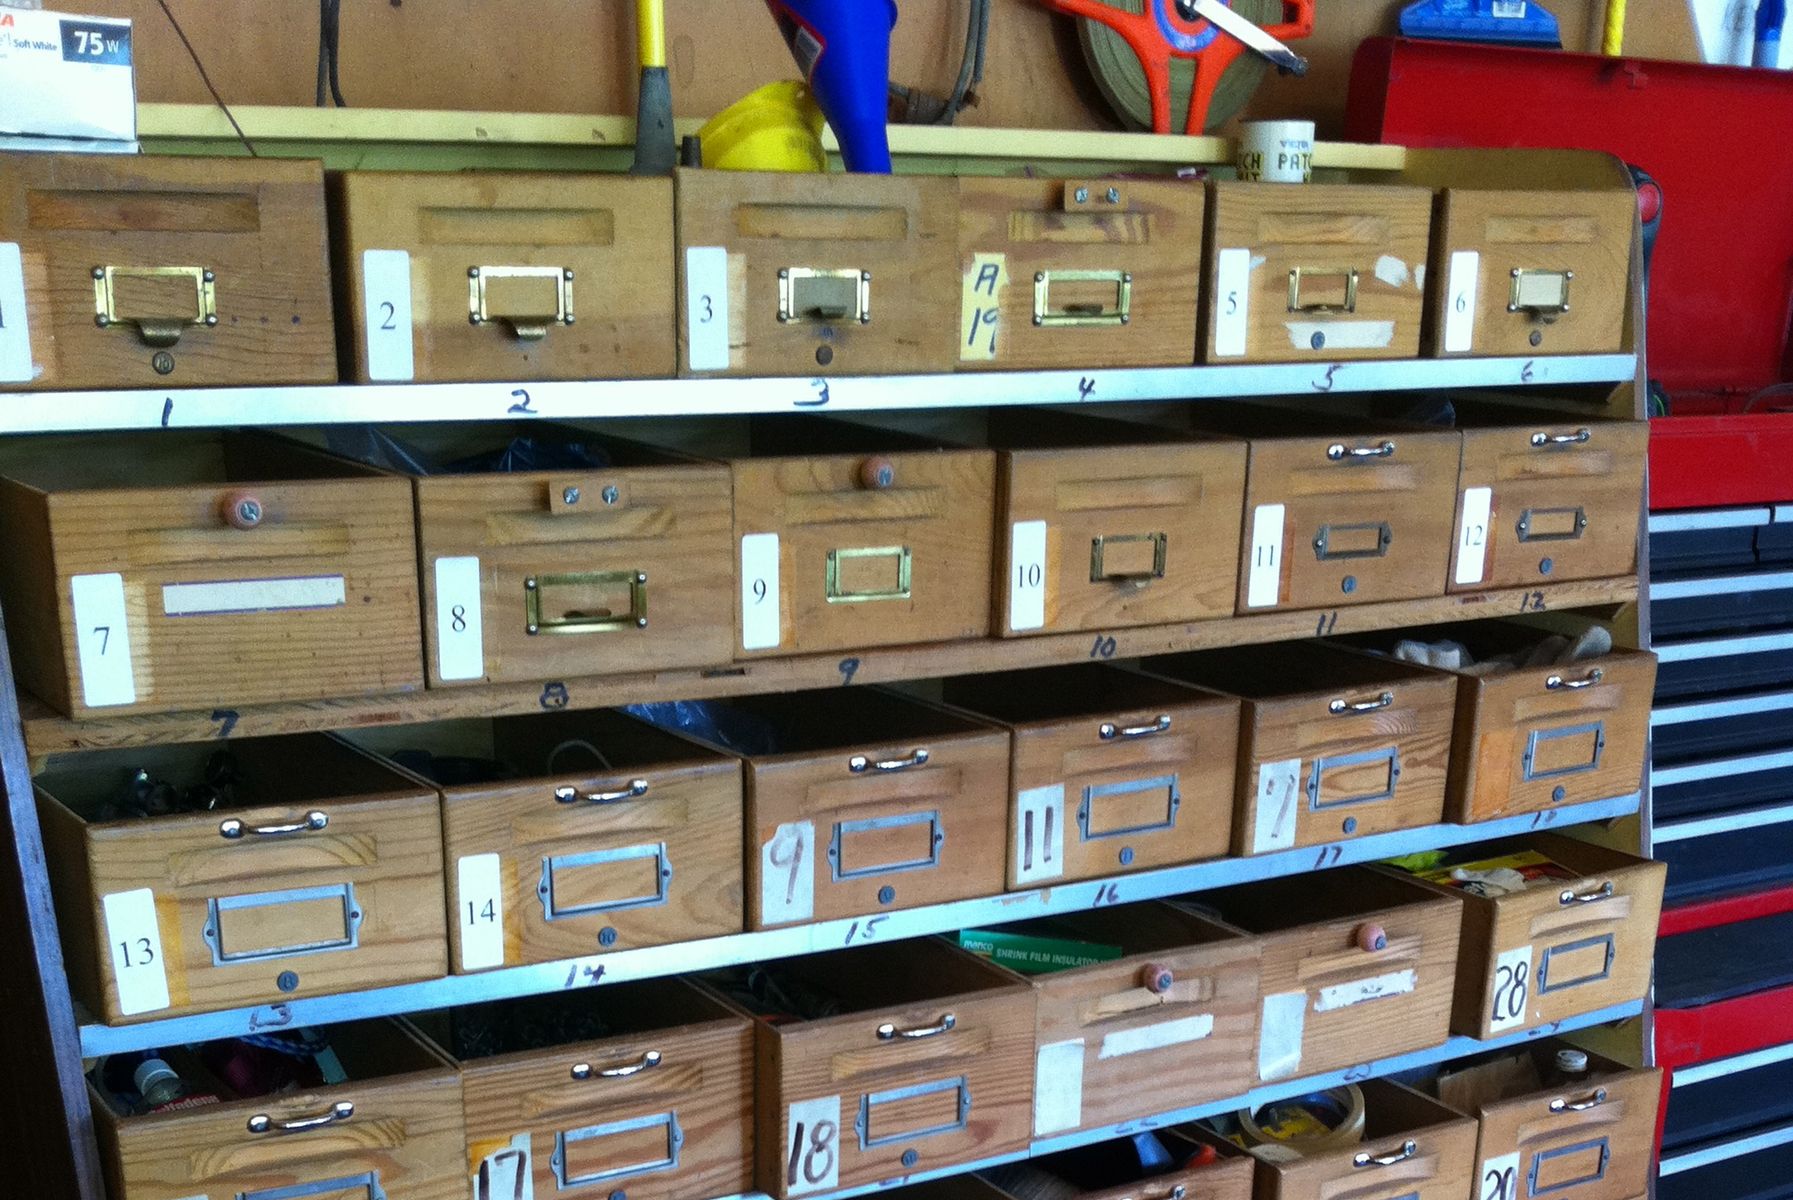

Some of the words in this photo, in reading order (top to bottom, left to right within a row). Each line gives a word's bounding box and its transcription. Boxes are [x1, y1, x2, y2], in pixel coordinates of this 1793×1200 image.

[13, 38, 31, 49] Soft
[32, 40, 58, 52] White
[700, 295, 713, 324] 3
[1226, 291, 1238, 317] 5
[1455, 288, 1466, 313] 6
[379, 301, 395, 331] 2
[507, 388, 539, 414] 2
[1078, 376, 1097, 400] 4
[1466, 525, 1483, 547] 12
[1258, 545, 1274, 567] 11
[1020, 563, 1041, 588] 10
[753, 578, 767, 606] 9
[451, 604, 467, 632] 8
[1316, 609, 1338, 636] 11
[93, 626, 110, 656] 7
[1090, 633, 1118, 660] 10
[837, 658, 861, 686] 9
[211, 709, 240, 737] 7
[1024, 806, 1055, 872] 11
[769, 826, 804, 905] 9
[1093, 882, 1120, 907] 16
[468, 897, 497, 925] 14
[845, 915, 891, 945] 15
[119, 937, 154, 968] 13
[996, 948, 1028, 962] SHRINK
[1030, 952, 1051, 963] FILM
[1493, 960, 1529, 1022] 28
[787, 1119, 836, 1186] 18
